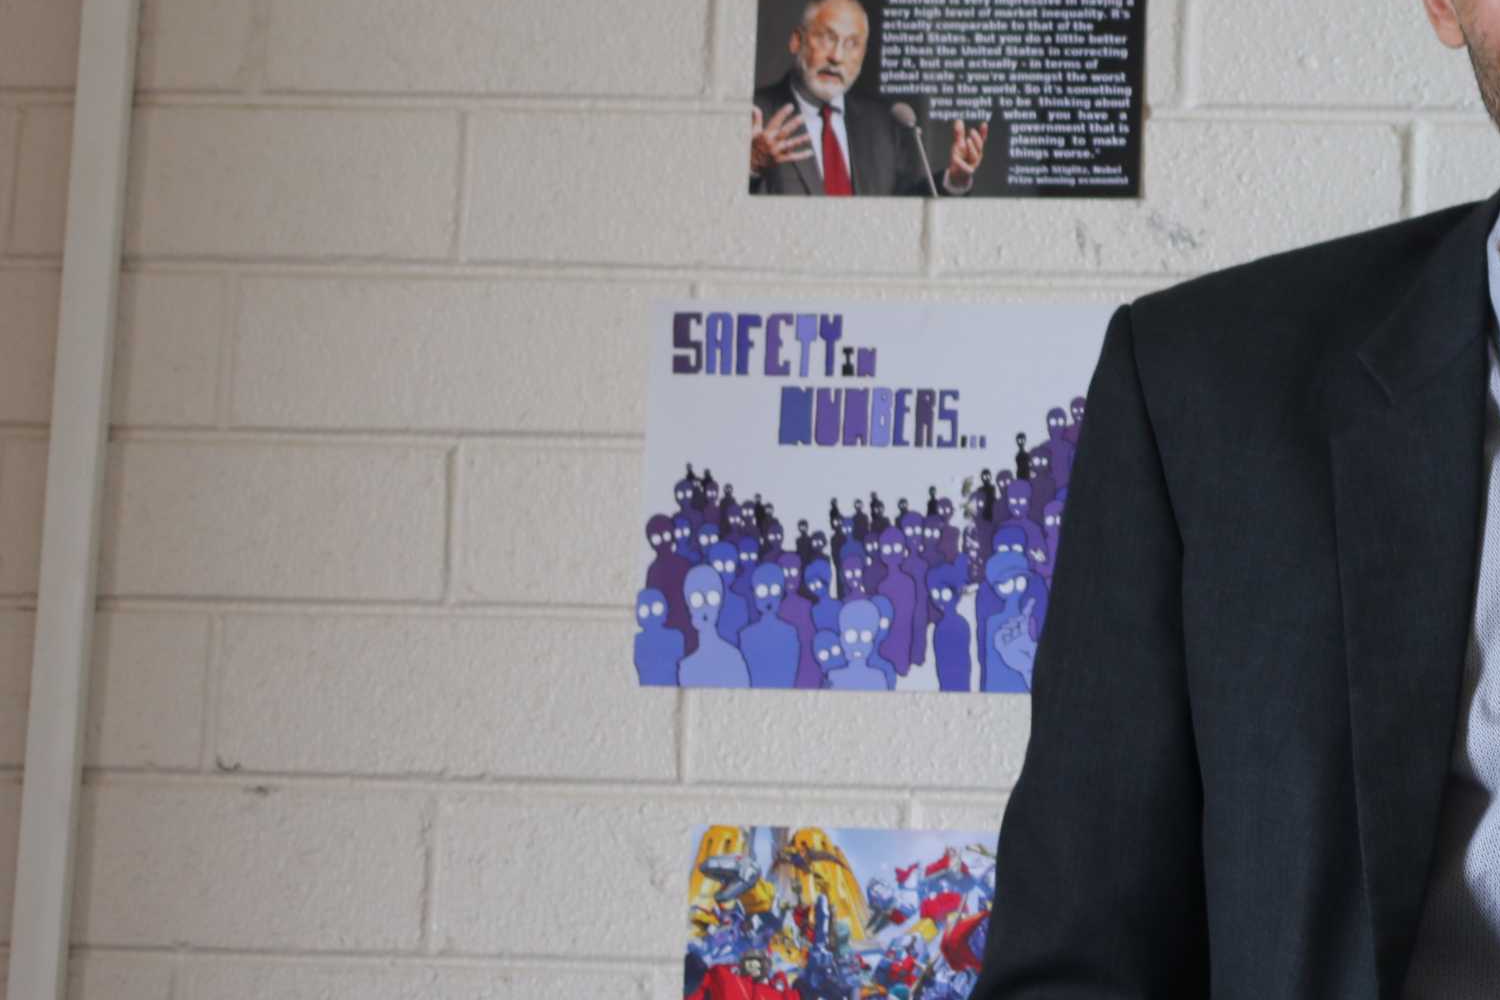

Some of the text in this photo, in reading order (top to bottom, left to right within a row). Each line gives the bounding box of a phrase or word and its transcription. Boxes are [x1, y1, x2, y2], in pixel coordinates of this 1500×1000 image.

[883, 10, 910, 19] very
[914, 7, 941, 20] high
[945, 8, 975, 18] level
[978, 8, 991, 18] of
[994, 8, 1037, 19] market
[1041, 9, 1107, 21] inequality.
[883, 20, 1094, 32] actually comparable to that of the
[883, 33, 1127, 45] United States. But you do a little better
[881, 46, 1128, 59] job than the United States in correcting
[882, 58, 898, 68] for
[920, 58, 939, 68] but
[944, 59, 964, 68] not
[968, 58, 1017, 70] actually
[1029, 60, 1041, 69] in
[1045, 60, 1081, 69] terms
[1085, 60, 1098, 69] of
[881, 71, 919, 82] global
[923, 71, 954, 81] scale
[967, 72, 1005, 83] you're
[1009, 72, 1062, 84] amongst
[1066, 72, 1086, 82] the
[1091, 73, 1125, 83] worst
[880, 83, 1132, 97] countries in the world. So it's something
[930, 97, 1130, 109] you ought to be thinking about
[930, 109, 1127, 122] especially when you have a
[1011, 123, 1129, 134] government that is
[1010, 136, 1127, 147] planning to make
[1009, 148, 1049, 160] things
[672, 312, 877, 378] SAFETY IN
